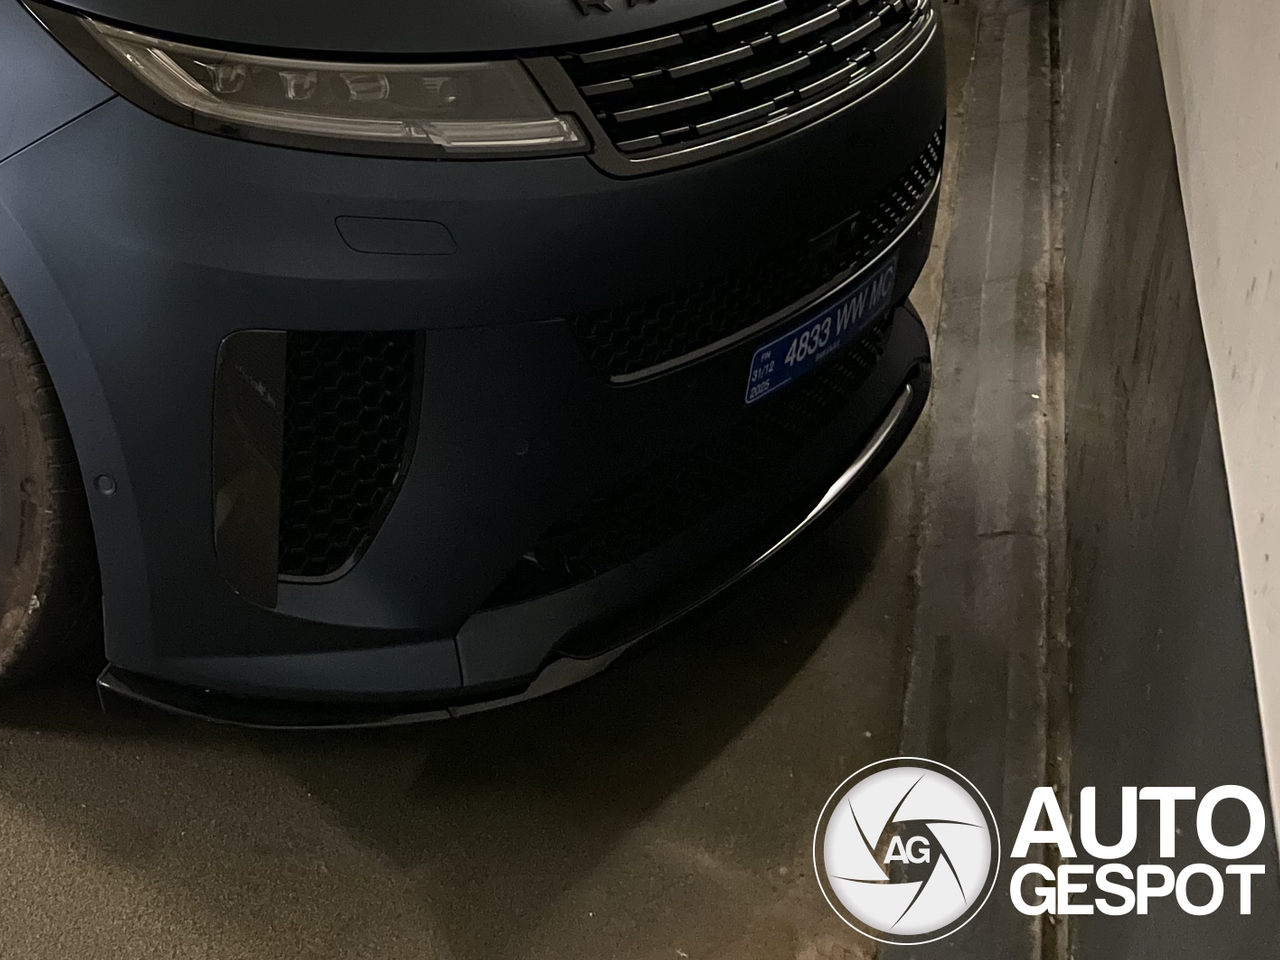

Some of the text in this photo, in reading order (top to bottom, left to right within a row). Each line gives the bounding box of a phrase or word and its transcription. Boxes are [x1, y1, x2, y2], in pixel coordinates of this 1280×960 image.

[784, 316, 832, 367] 4833
[836, 287, 869, 336] WW
[751, 360, 775, 382] 31/12
